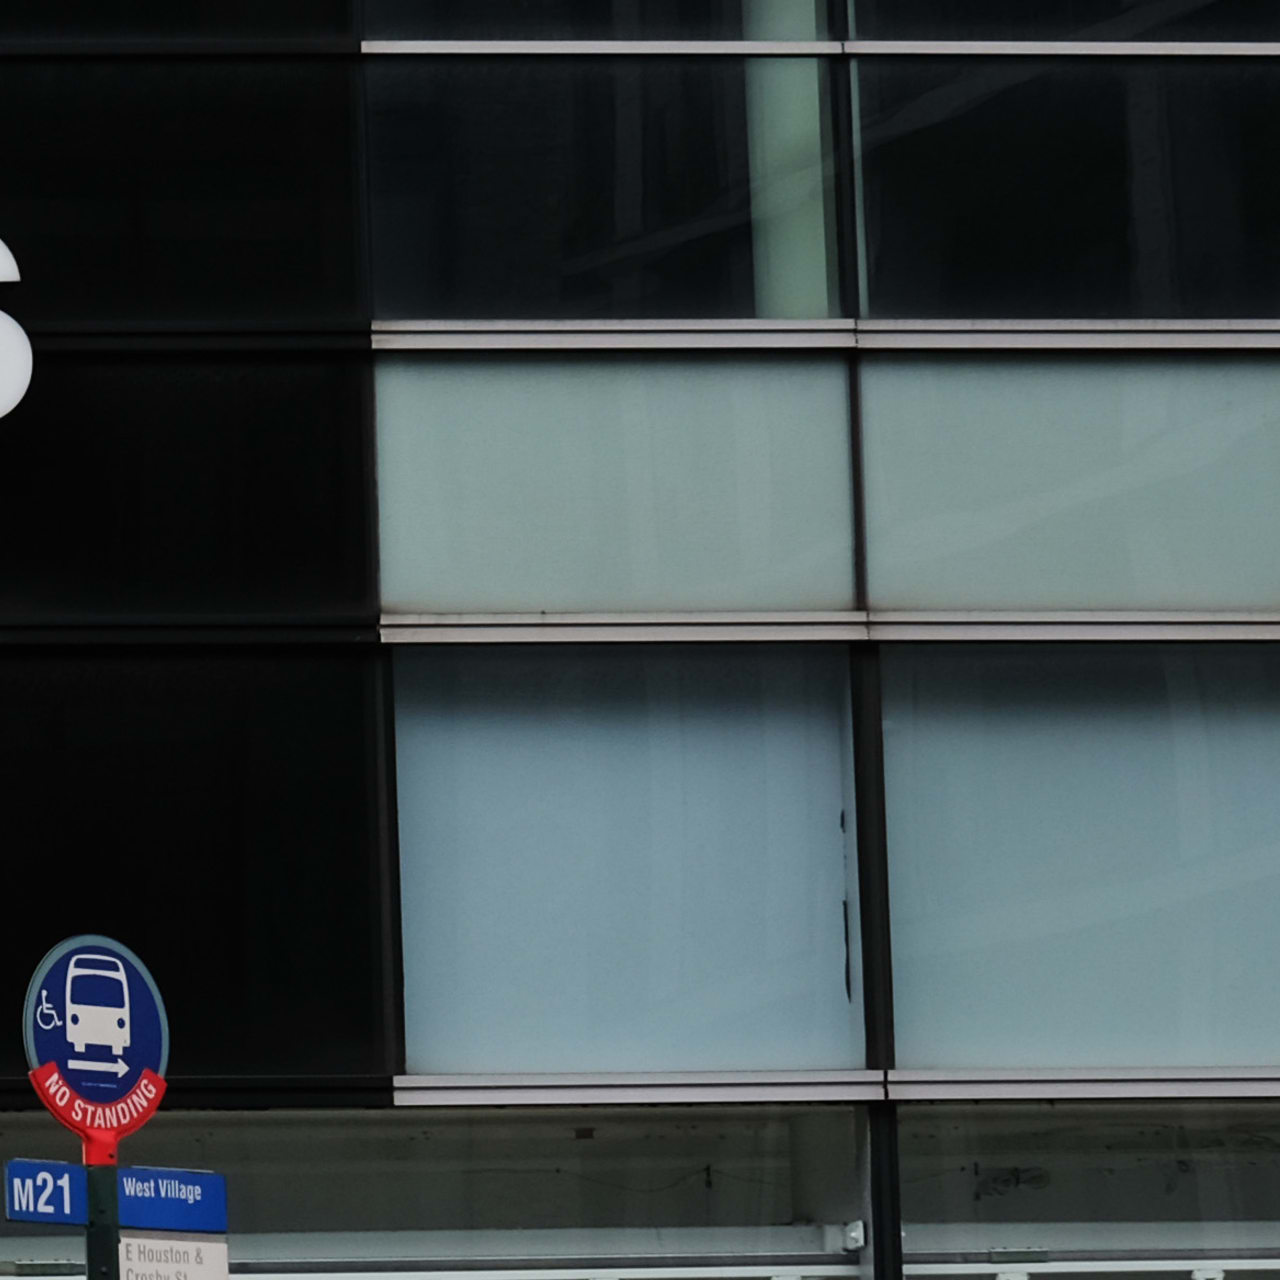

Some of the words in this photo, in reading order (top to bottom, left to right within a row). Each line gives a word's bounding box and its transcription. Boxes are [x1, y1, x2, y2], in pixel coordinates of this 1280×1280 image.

[44, 1072, 70, 1107] NO
[72, 1079, 157, 1129] STANDING
[13, 1171, 71, 1215] M21
[123, 1177, 155, 1198] West
[158, 1179, 202, 1204] Village
[125, 1243, 133, 1261] E
[139, 1245, 190, 1265] Houston
[194, 1247, 204, 1265] &
